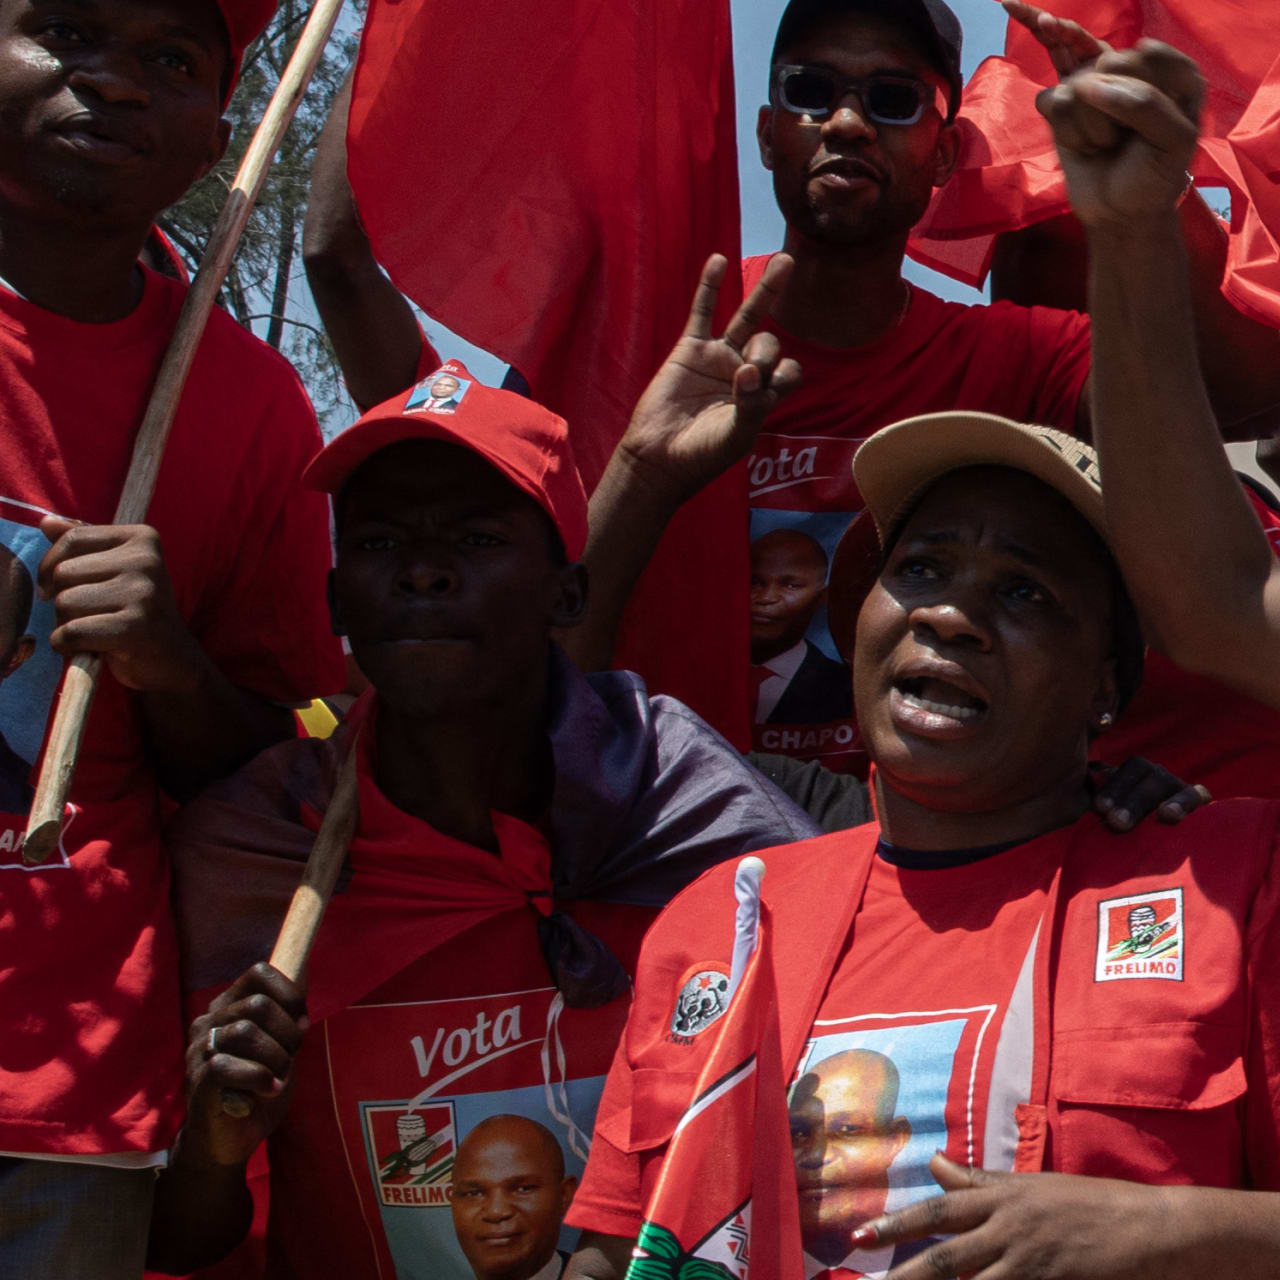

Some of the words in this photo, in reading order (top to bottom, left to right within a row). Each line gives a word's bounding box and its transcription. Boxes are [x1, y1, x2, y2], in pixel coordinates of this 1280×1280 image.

[747, 446, 818, 486] ota
[761, 724, 854, 749] CHAPO
[1103, 960, 1177, 979] FRELIMO
[410, 1004, 522, 1079] Vota
